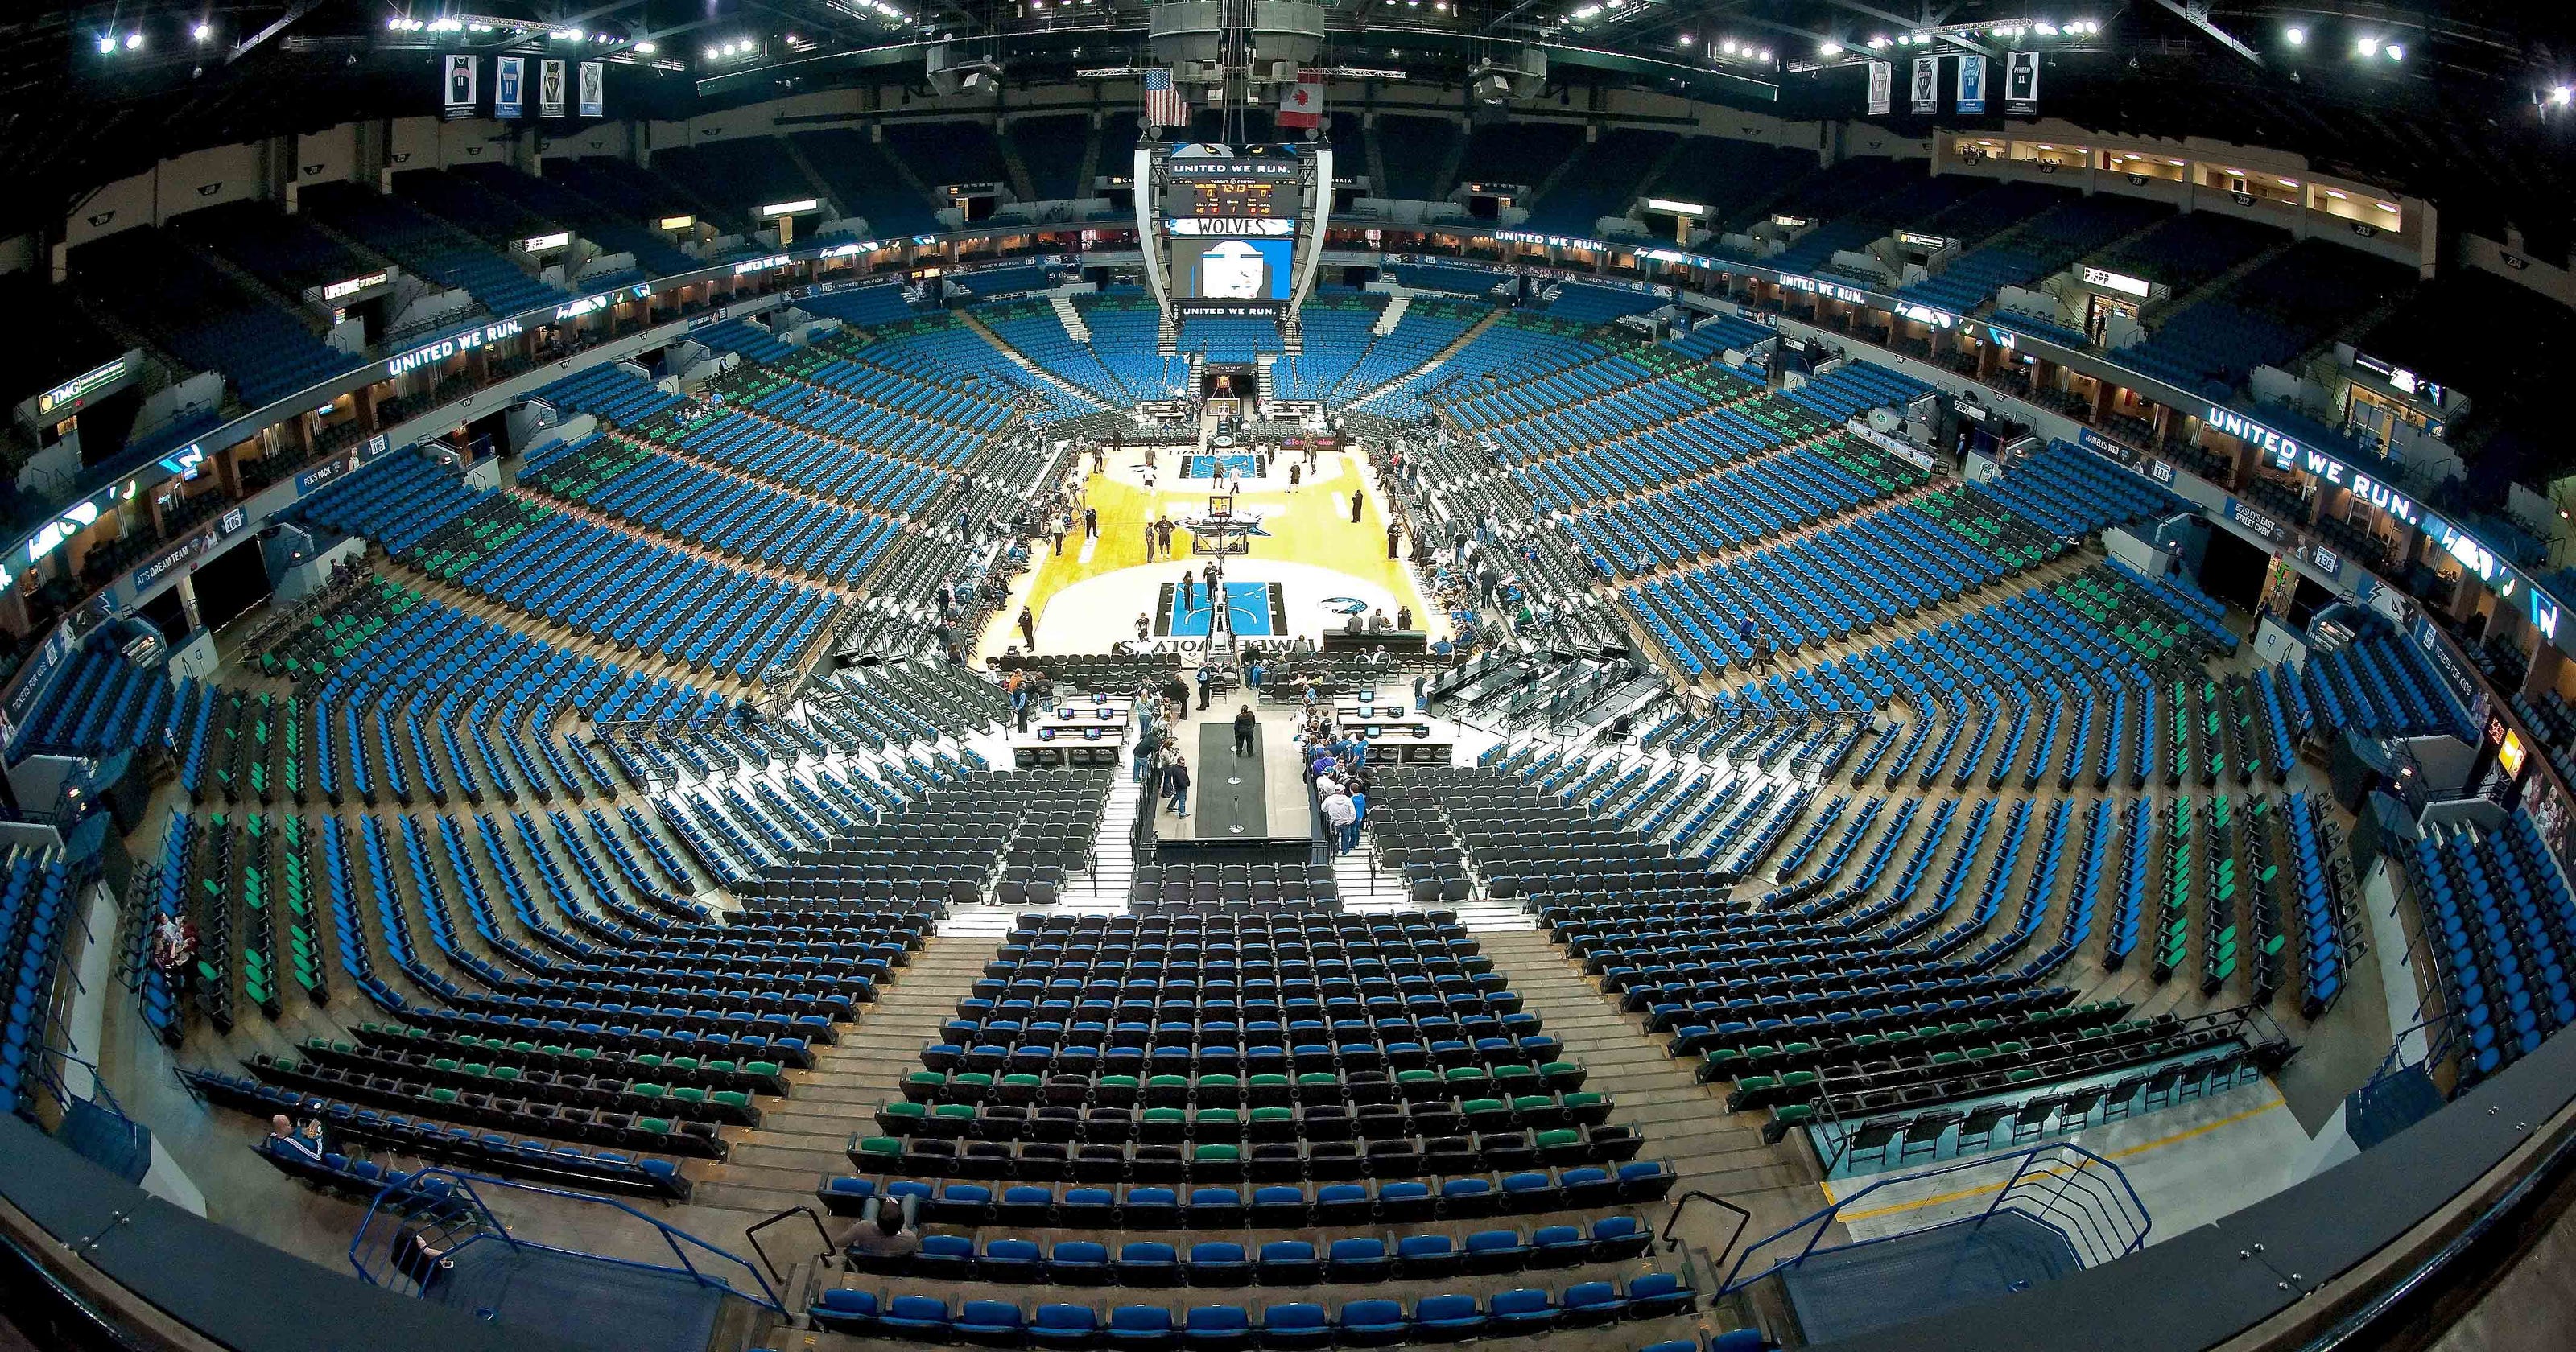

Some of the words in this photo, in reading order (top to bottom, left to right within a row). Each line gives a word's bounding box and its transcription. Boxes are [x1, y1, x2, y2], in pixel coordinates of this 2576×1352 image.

[1174, 165, 1226, 173] UNITED
[1232, 165, 1252, 173] WE
[1257, 165, 1291, 174] RUN.
[1198, 217, 1266, 235] WOLVES
[1496, 232, 1544, 245] UNITED
[1549, 237, 1569, 247] WE
[1573, 240, 1608, 252] RUN.
[1779, 274, 1816, 292] UNITED
[1818, 282, 1835, 297] WE
[1183, 307, 1225, 315] UNITED
[1228, 307, 1245, 315] WE
[1249, 307, 1277, 315] RUN.
[389, 340, 453, 376] UNITED
[458, 331, 482, 351] WE
[487, 319, 523, 343] RUN.
[52, 381, 80, 404] TMG
[2107, 443, 2120, 455] WEB
[2155, 468, 2168, 480] 133
[2209, 407, 2297, 460] UNITED
[2306, 450, 2343, 484] WE
[2352, 474, 2417, 526] RUN.
[226, 516, 240, 530] 106
[2235, 503, 2261, 523] BEASLEY'S
[2260, 517, 2276, 531] EASY
[2235, 513, 2255, 529] STREET
[2255, 521, 2271, 538] CREW
[137, 570, 151, 587] AT'S
[150, 556, 172, 578] DREAM
[171, 546, 190, 563] TEAM
[2318, 554, 2332, 570] 136
